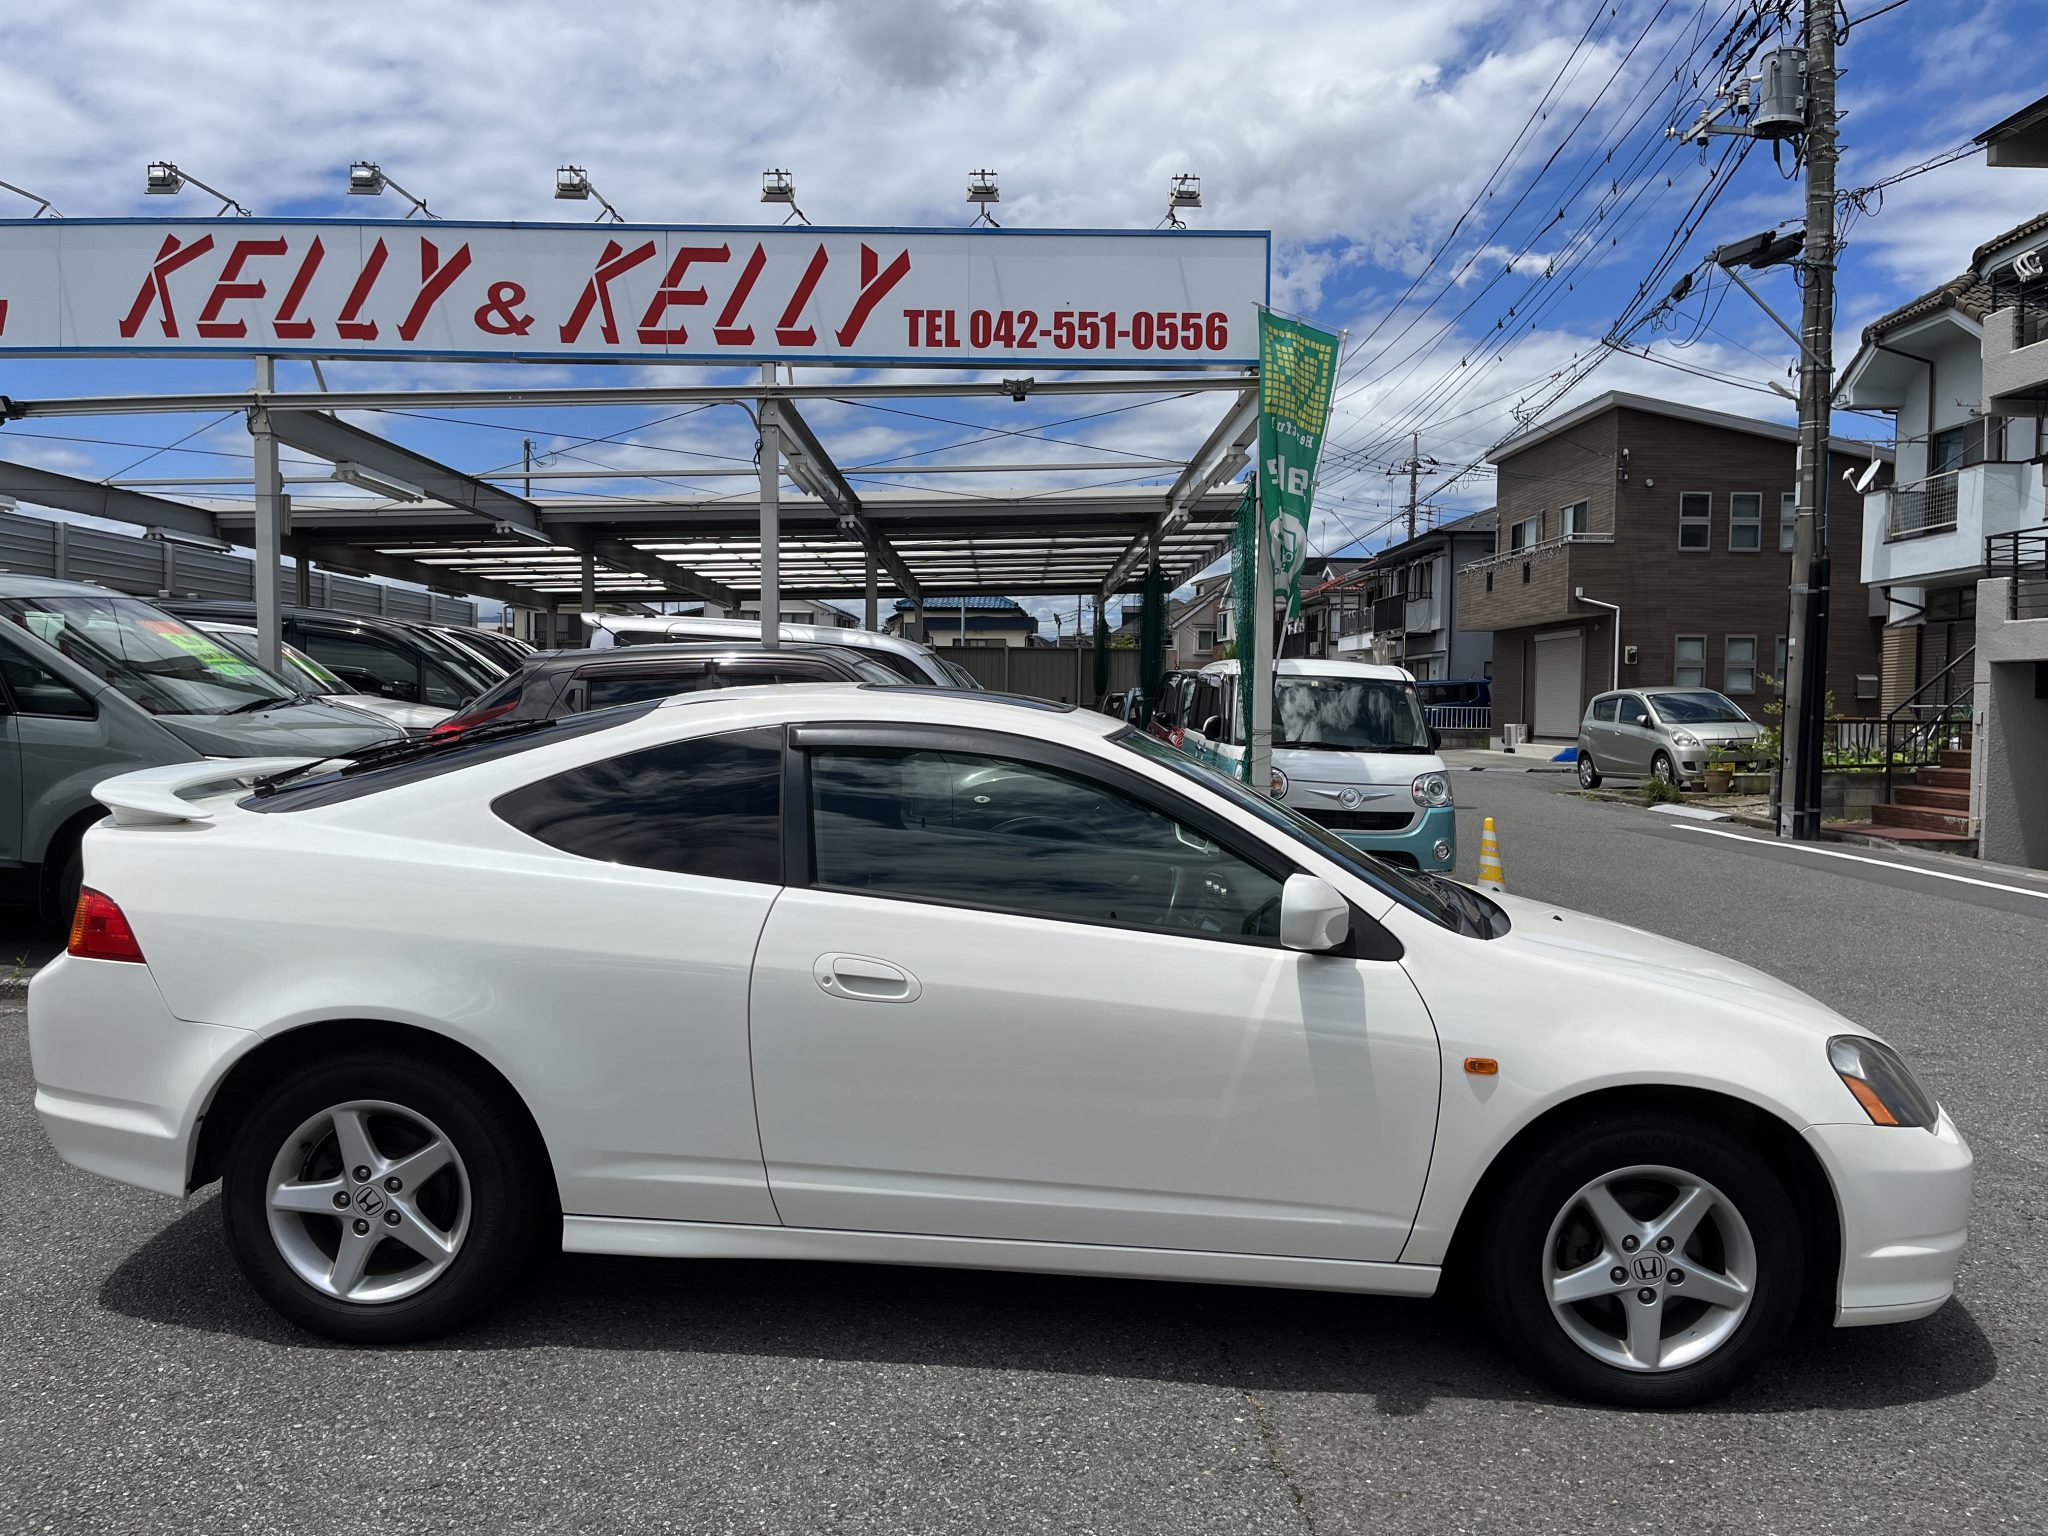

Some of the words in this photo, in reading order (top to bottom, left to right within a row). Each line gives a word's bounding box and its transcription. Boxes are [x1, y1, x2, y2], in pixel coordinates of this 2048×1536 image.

[119, 233, 472, 341] KELLY
[474, 281, 534, 336] &
[559, 240, 911, 347] KELLY
[904, 309, 961, 347] TEL
[970, 310, 1228, 351] 042-551-0556
